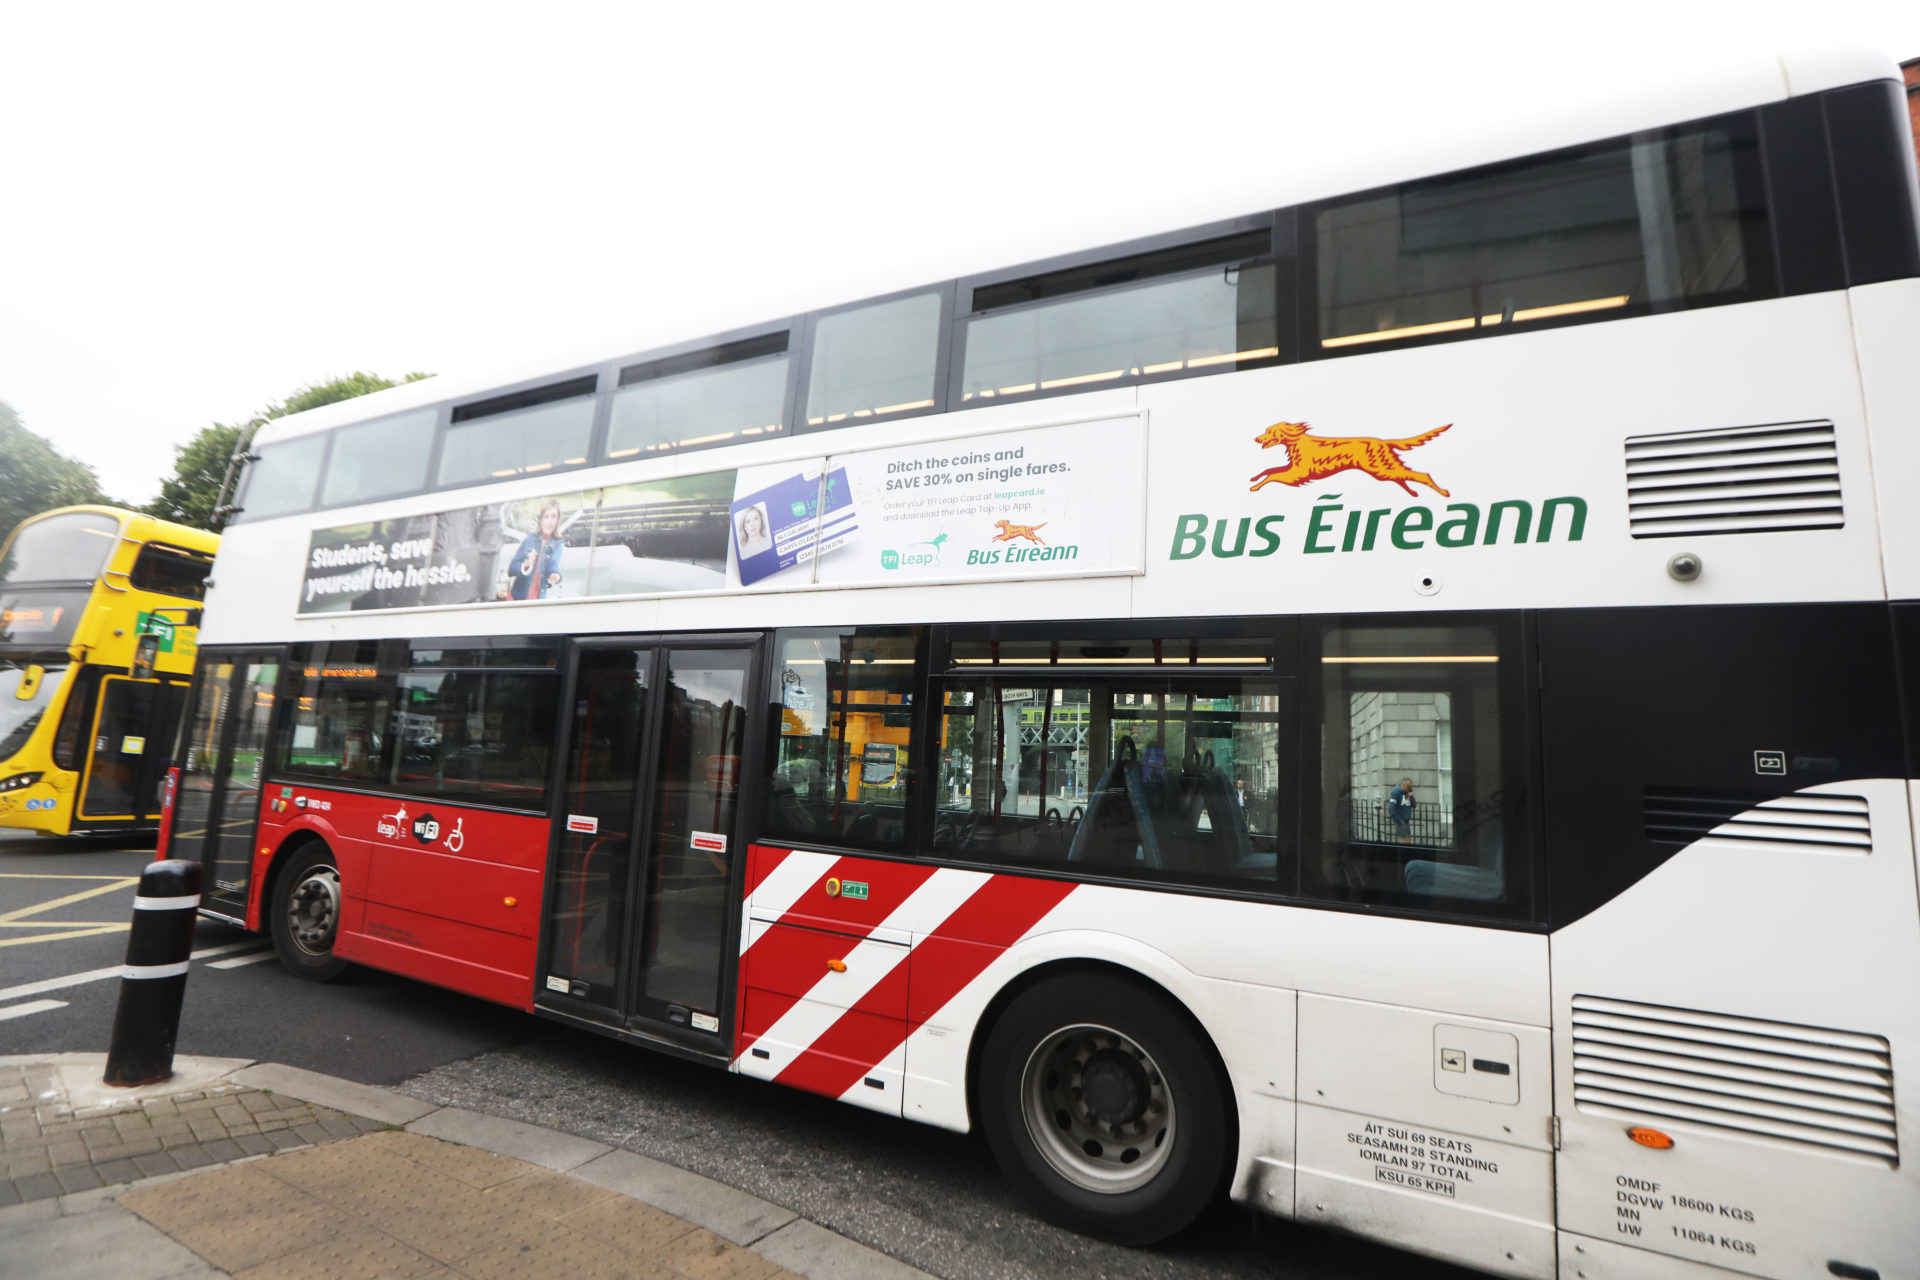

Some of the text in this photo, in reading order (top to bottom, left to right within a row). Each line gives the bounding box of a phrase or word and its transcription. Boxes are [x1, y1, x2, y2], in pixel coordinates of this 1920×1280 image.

[887, 446, 1024, 474] Ditch the coins and
[886, 462, 1071, 491] SAVE 30% on single fares.
[883, 500, 906, 510] Order
[907, 500, 925, 511] your
[927, 498, 937, 506] TFI
[939, 496, 958, 508] Leap
[960, 493, 981, 502] Card
[994, 487, 1046, 500] leapcard.ie
[883, 512, 899, 521] and
[900, 509, 940, 521] download
[941, 508, 955, 516] the
[956, 505, 977, 516] Leap
[979, 503, 1011, 514] Top-Up
[1168, 493, 1588, 561] Bus Éireann
[311, 538, 432, 568] Students, save
[883, 552, 933, 567] TFI Leap
[966, 543, 1079, 565] Bus Éireann
[305, 563, 377, 602] yourself
[374, 565, 404, 590] the
[1364, 1121, 1473, 1153] ÁIT SUÍ 69 SEATS
[1347, 1132, 1498, 1174] SEASAMH 28 STANDING
[1359, 1148, 1473, 1182] IOMLAN 97 TOTAL
[1378, 1169, 1453, 1194] KSU 65 KPH
[1616, 1175, 1661, 1193] OMDF
[1616, 1190, 1755, 1222] DGVW 18600 KGS
[1617, 1206, 1640, 1221] MN
[1617, 1221, 1756, 1255] UW 11064 KGS
